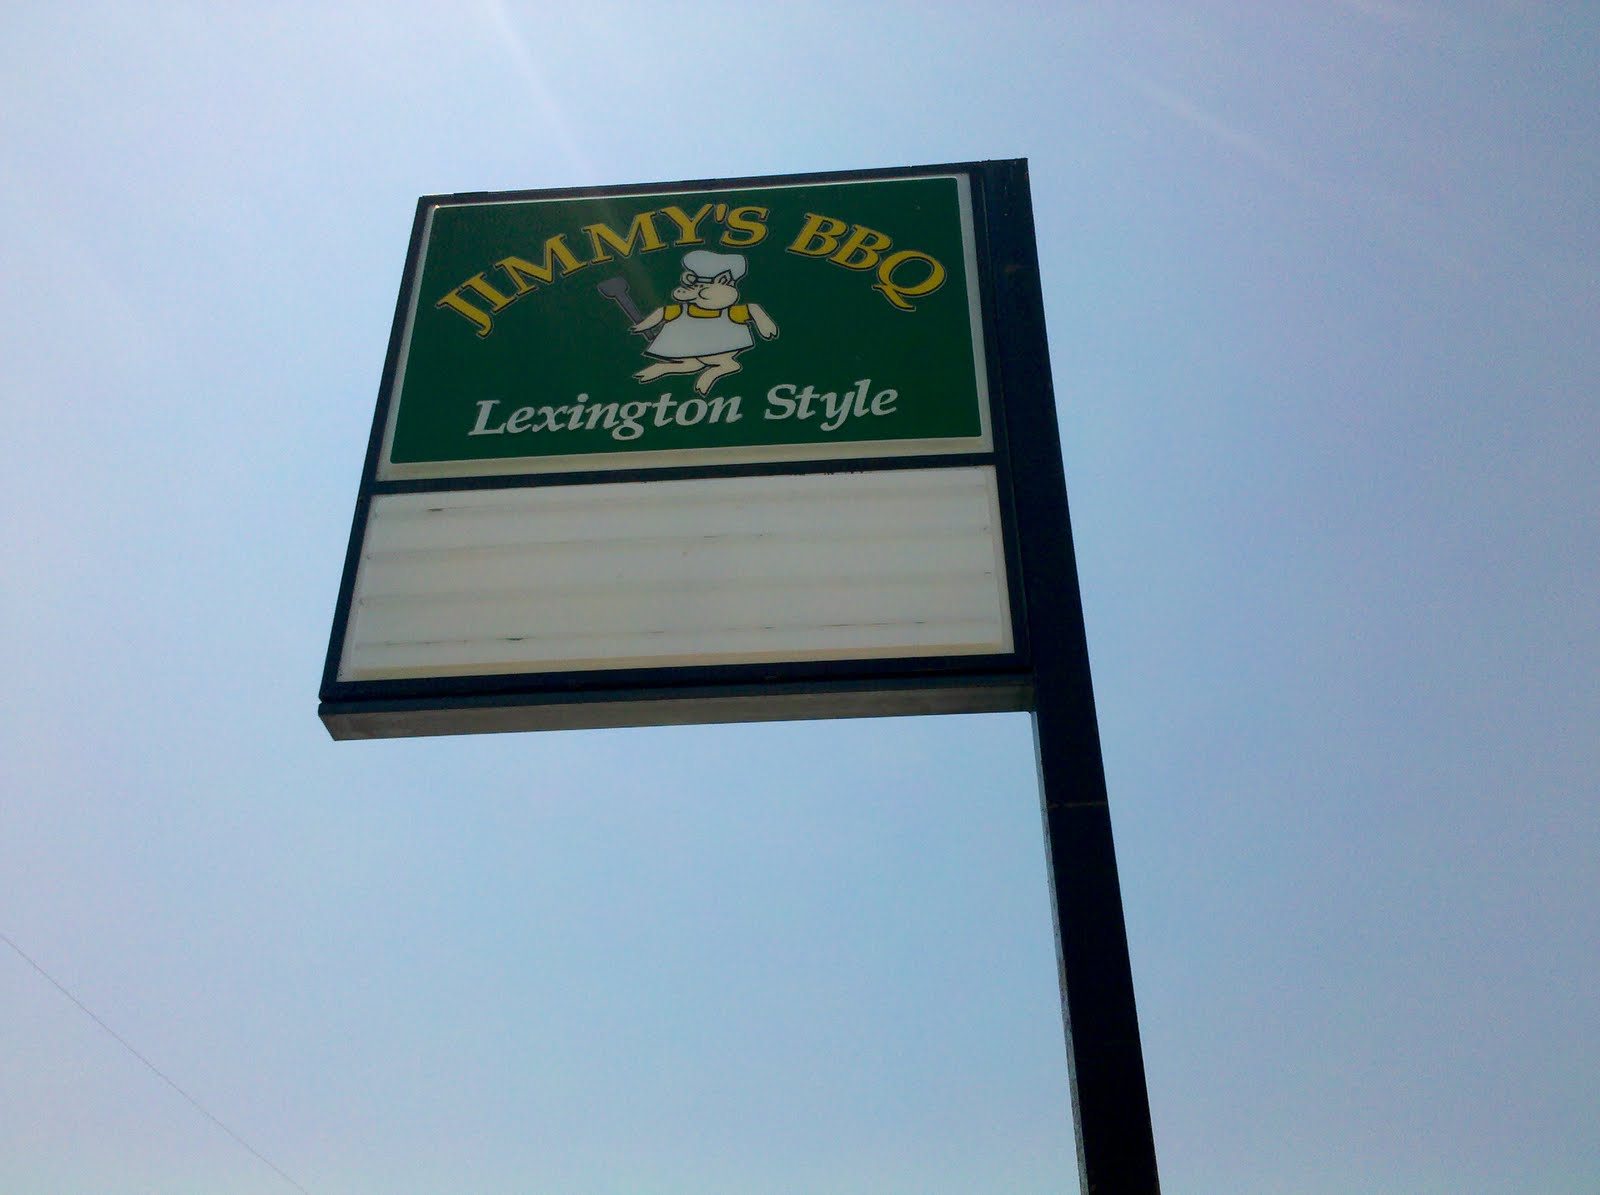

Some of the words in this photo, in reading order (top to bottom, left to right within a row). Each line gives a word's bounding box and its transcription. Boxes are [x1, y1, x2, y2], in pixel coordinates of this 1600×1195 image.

[436, 203, 769, 338] JIMMY'S
[787, 212, 947, 311] BBQ
[468, 393, 742, 441] Lexington
[763, 378, 899, 432] Style
